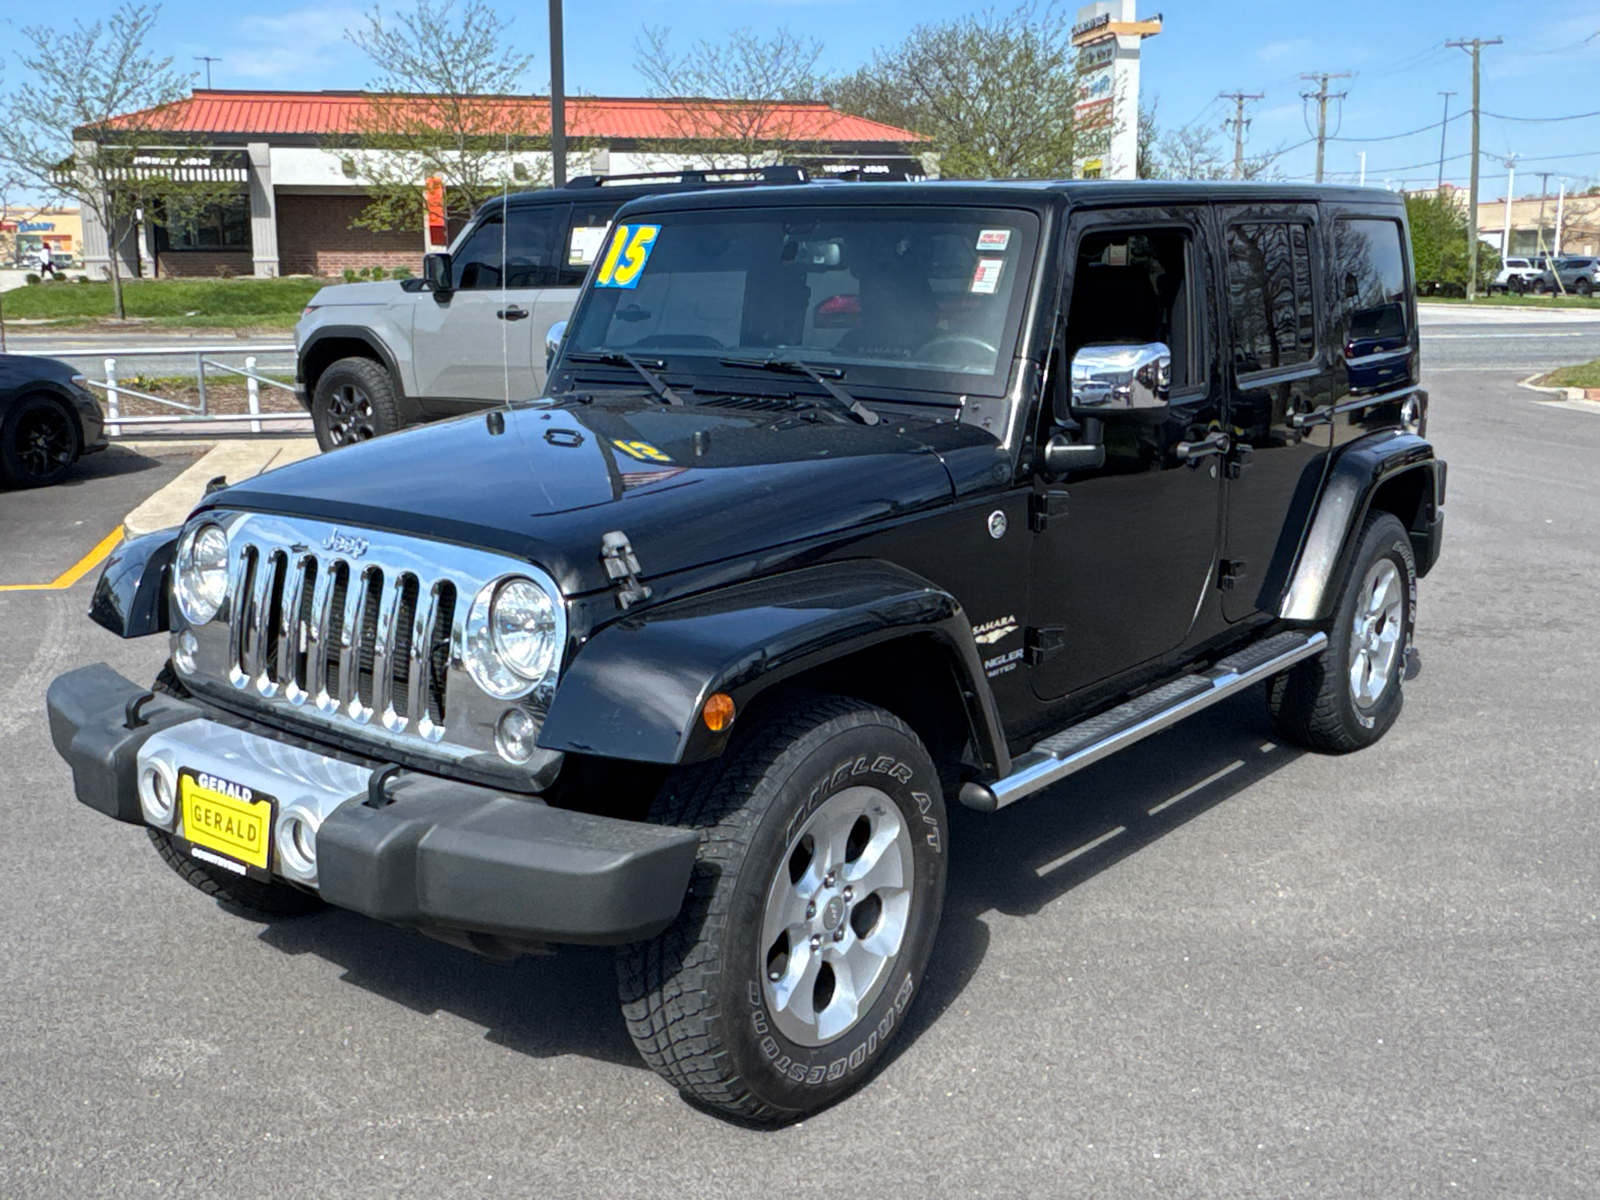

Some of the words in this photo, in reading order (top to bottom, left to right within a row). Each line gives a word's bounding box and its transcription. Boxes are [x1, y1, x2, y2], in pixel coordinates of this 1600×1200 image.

[598, 225, 657, 285] 15
[322, 527, 369, 560] Jeep
[984, 648, 1025, 670] NGLER
[986, 662, 1017, 678] MITED
[198, 773, 252, 803] GERALD
[193, 804, 257, 842] GERALD
